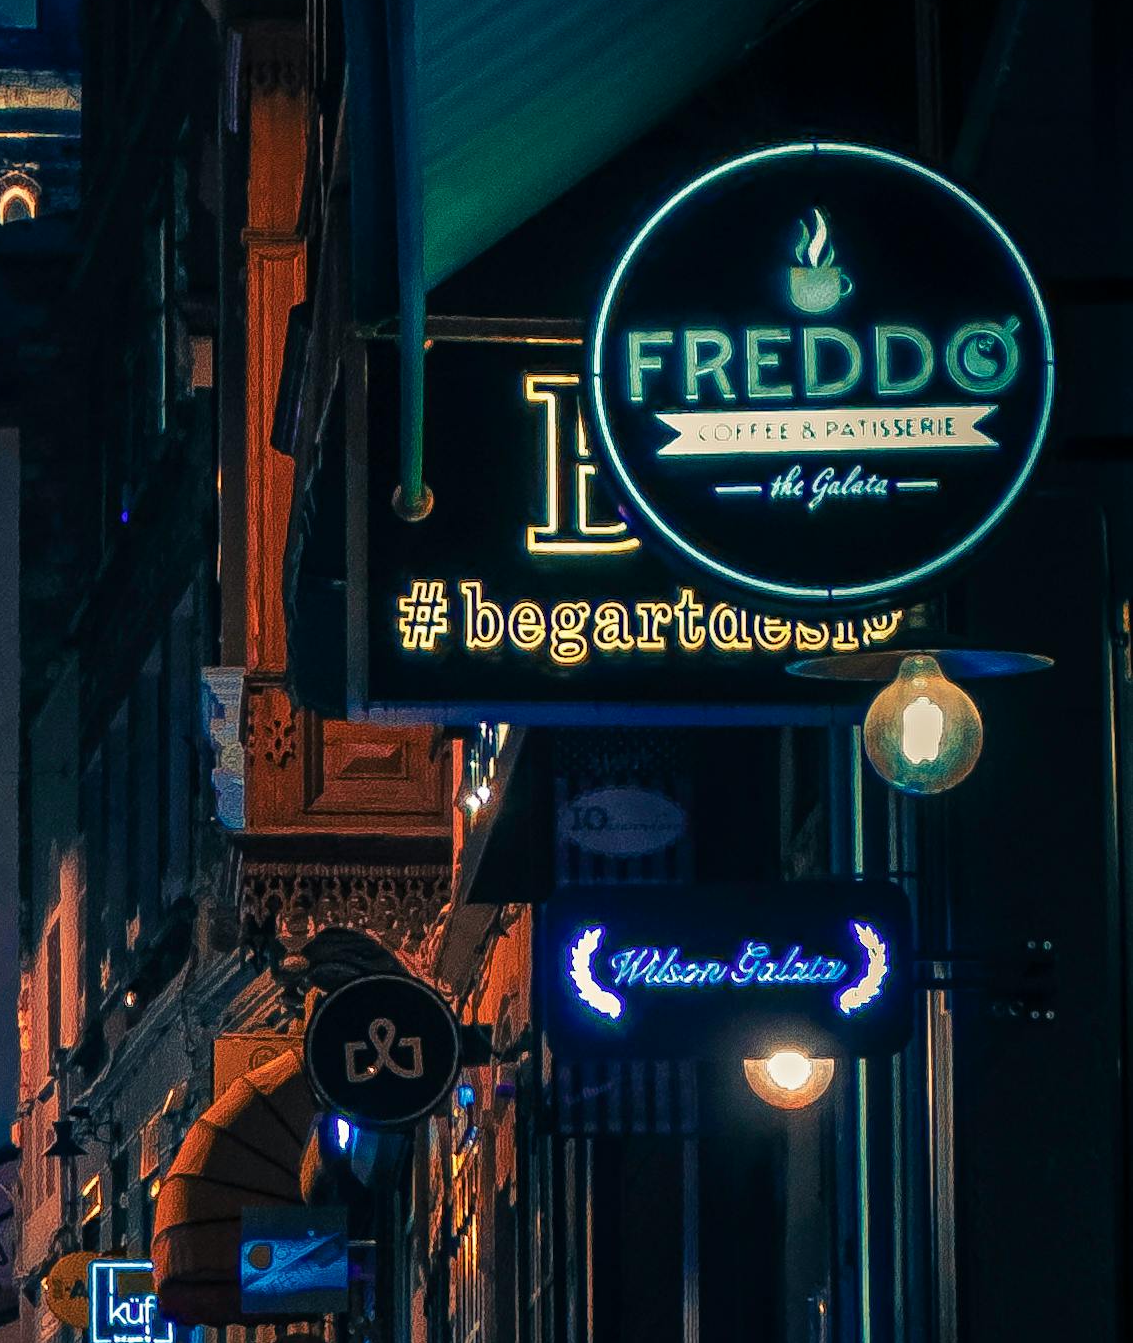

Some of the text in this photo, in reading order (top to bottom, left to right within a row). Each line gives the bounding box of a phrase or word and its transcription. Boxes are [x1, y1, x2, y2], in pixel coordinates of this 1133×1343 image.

[628, 316, 1021, 403] FREDDO
[697, 416, 958, 443] COFFEE & PATISSERIE
[770, 464, 889, 510] the Galata
[611, 941, 848, 985] Wilson Galata
